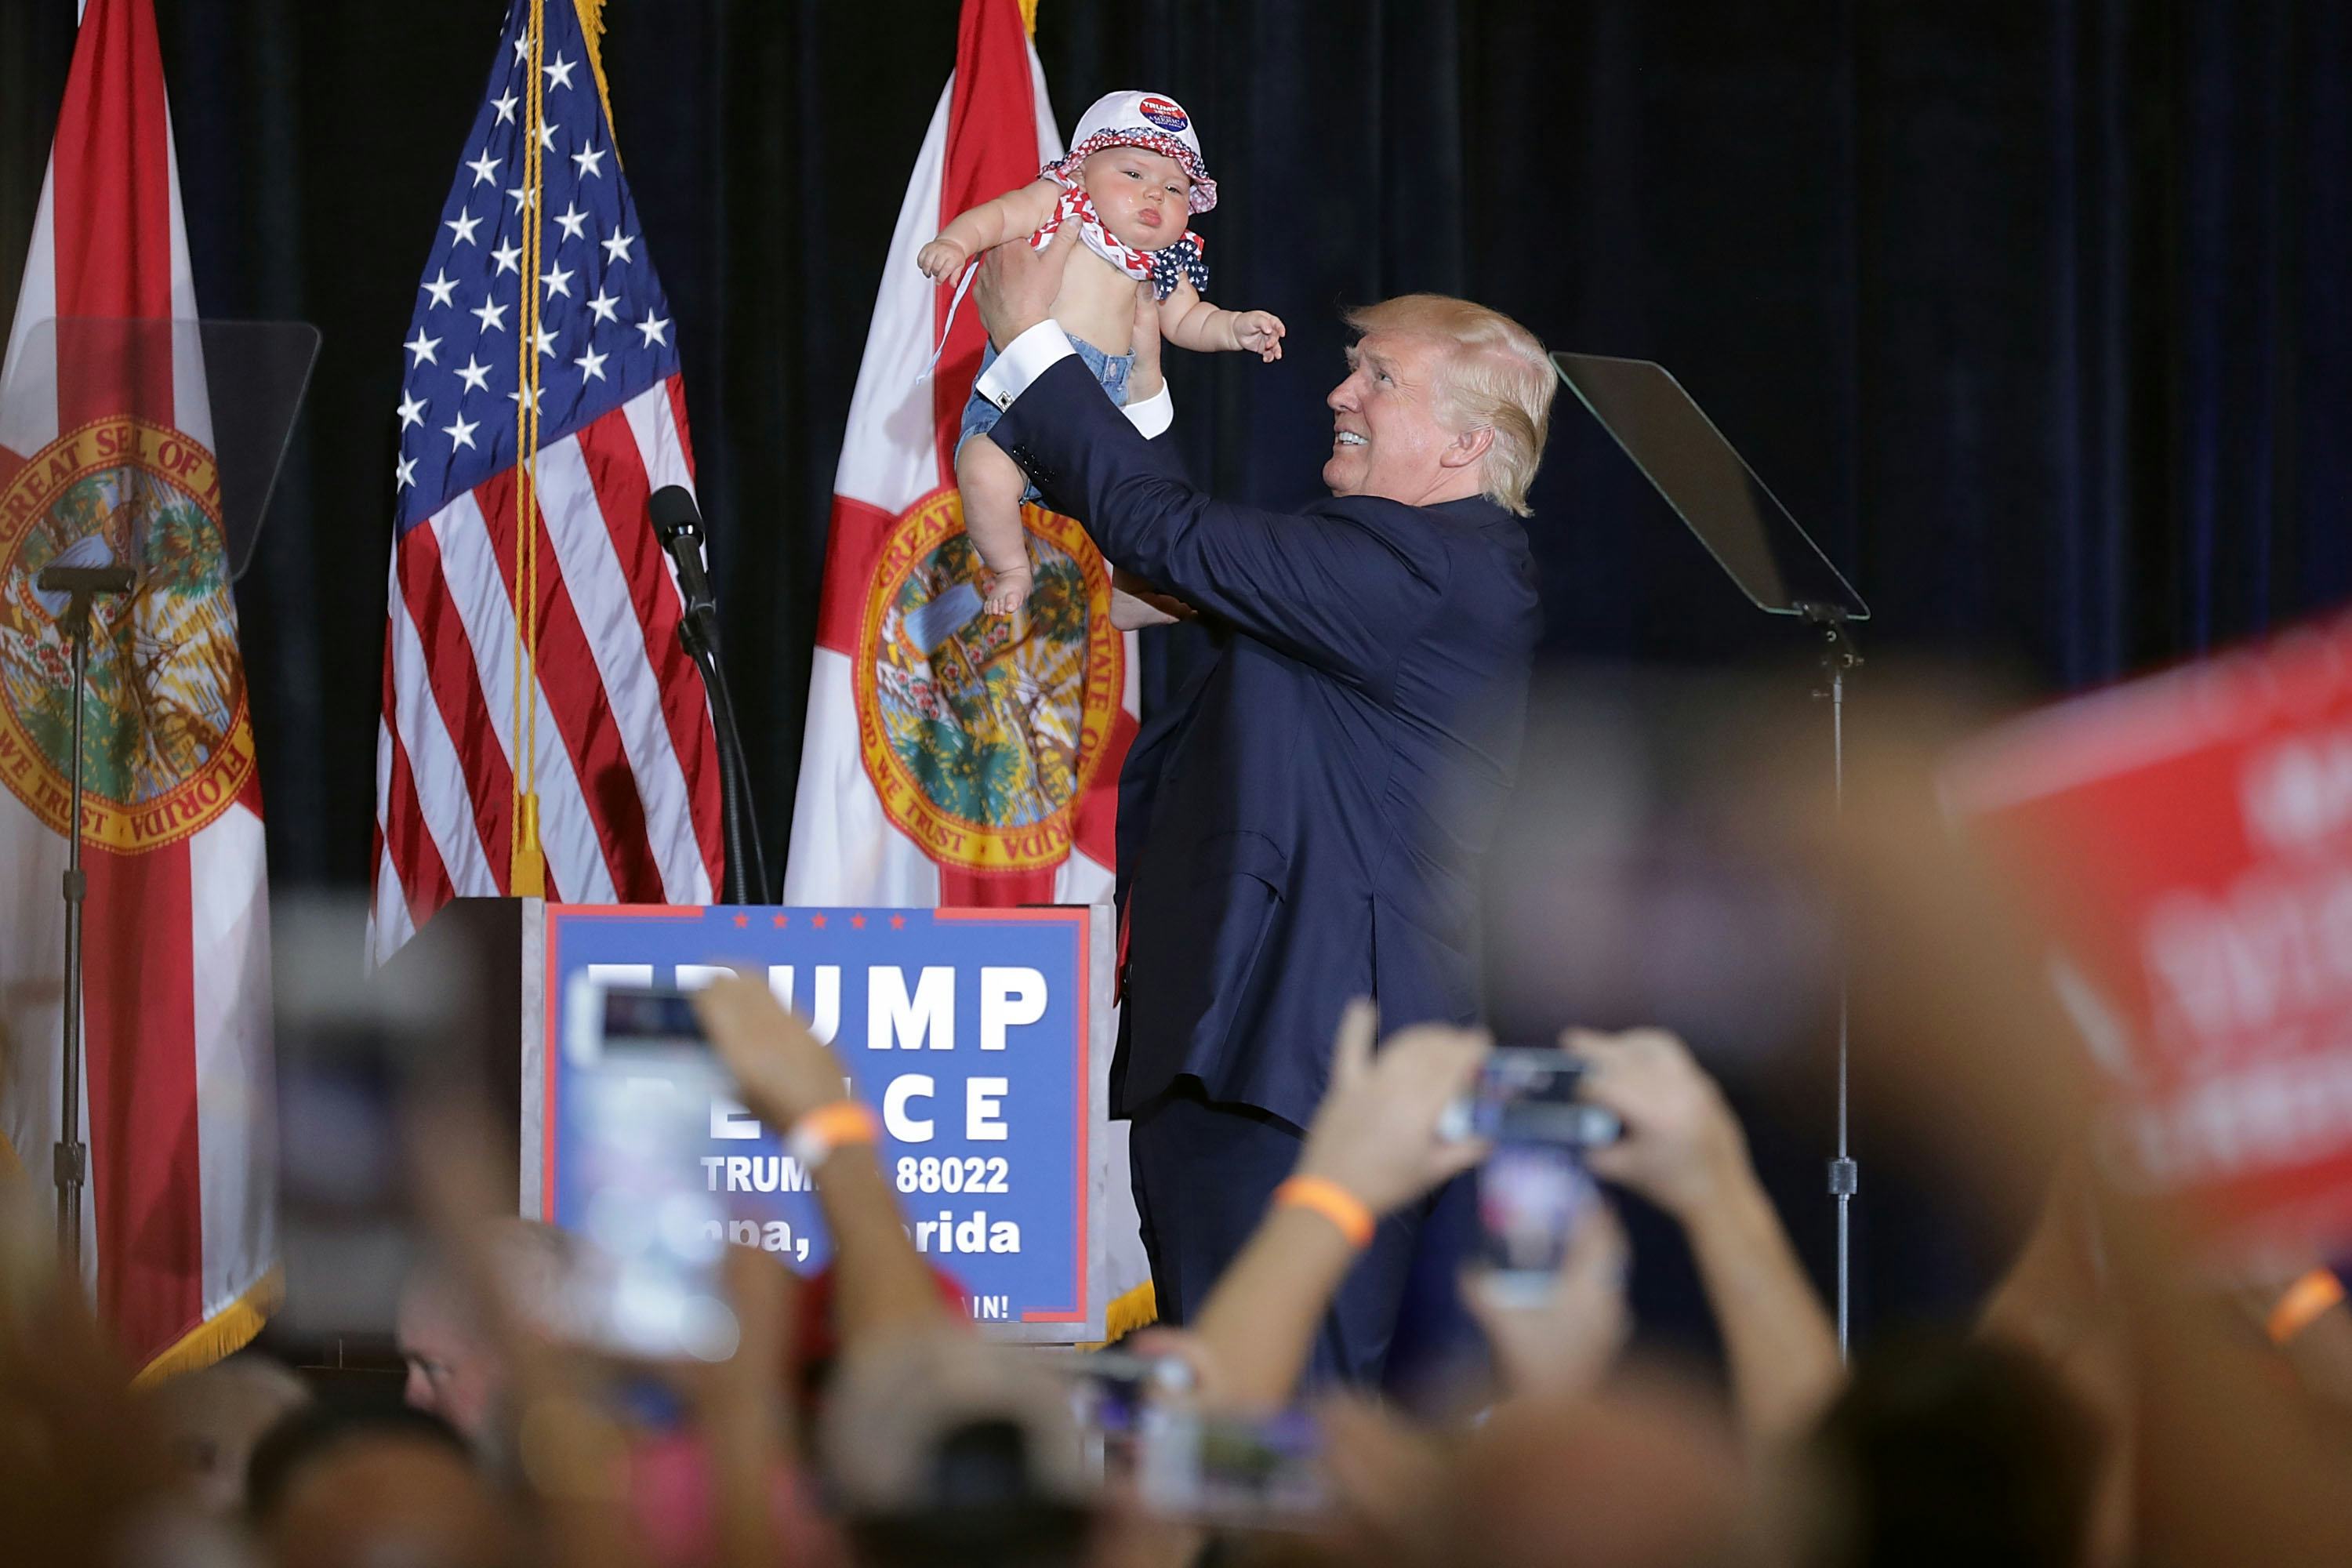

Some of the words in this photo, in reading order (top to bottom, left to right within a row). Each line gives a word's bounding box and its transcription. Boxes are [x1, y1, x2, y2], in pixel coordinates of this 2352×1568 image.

[1142, 100, 1179, 112] TRUMP
[1149, 115, 1186, 127] AMERICA
[0, 441, 82, 543] GREAT
[96, 427, 147, 459] SEL
[158, 440, 202, 475] OF
[878, 502, 956, 588] GREAT
[1091, 614, 1112, 712] STATE
[130, 745, 249, 842] FLORIDA
[905, 797, 966, 854] TRUST
[1000, 818, 1075, 860] RIDA
[625, 1073, 1008, 1143] ECE
[700, 1156, 821, 1192] TRUM
[896, 1156, 1009, 1193] 88022
